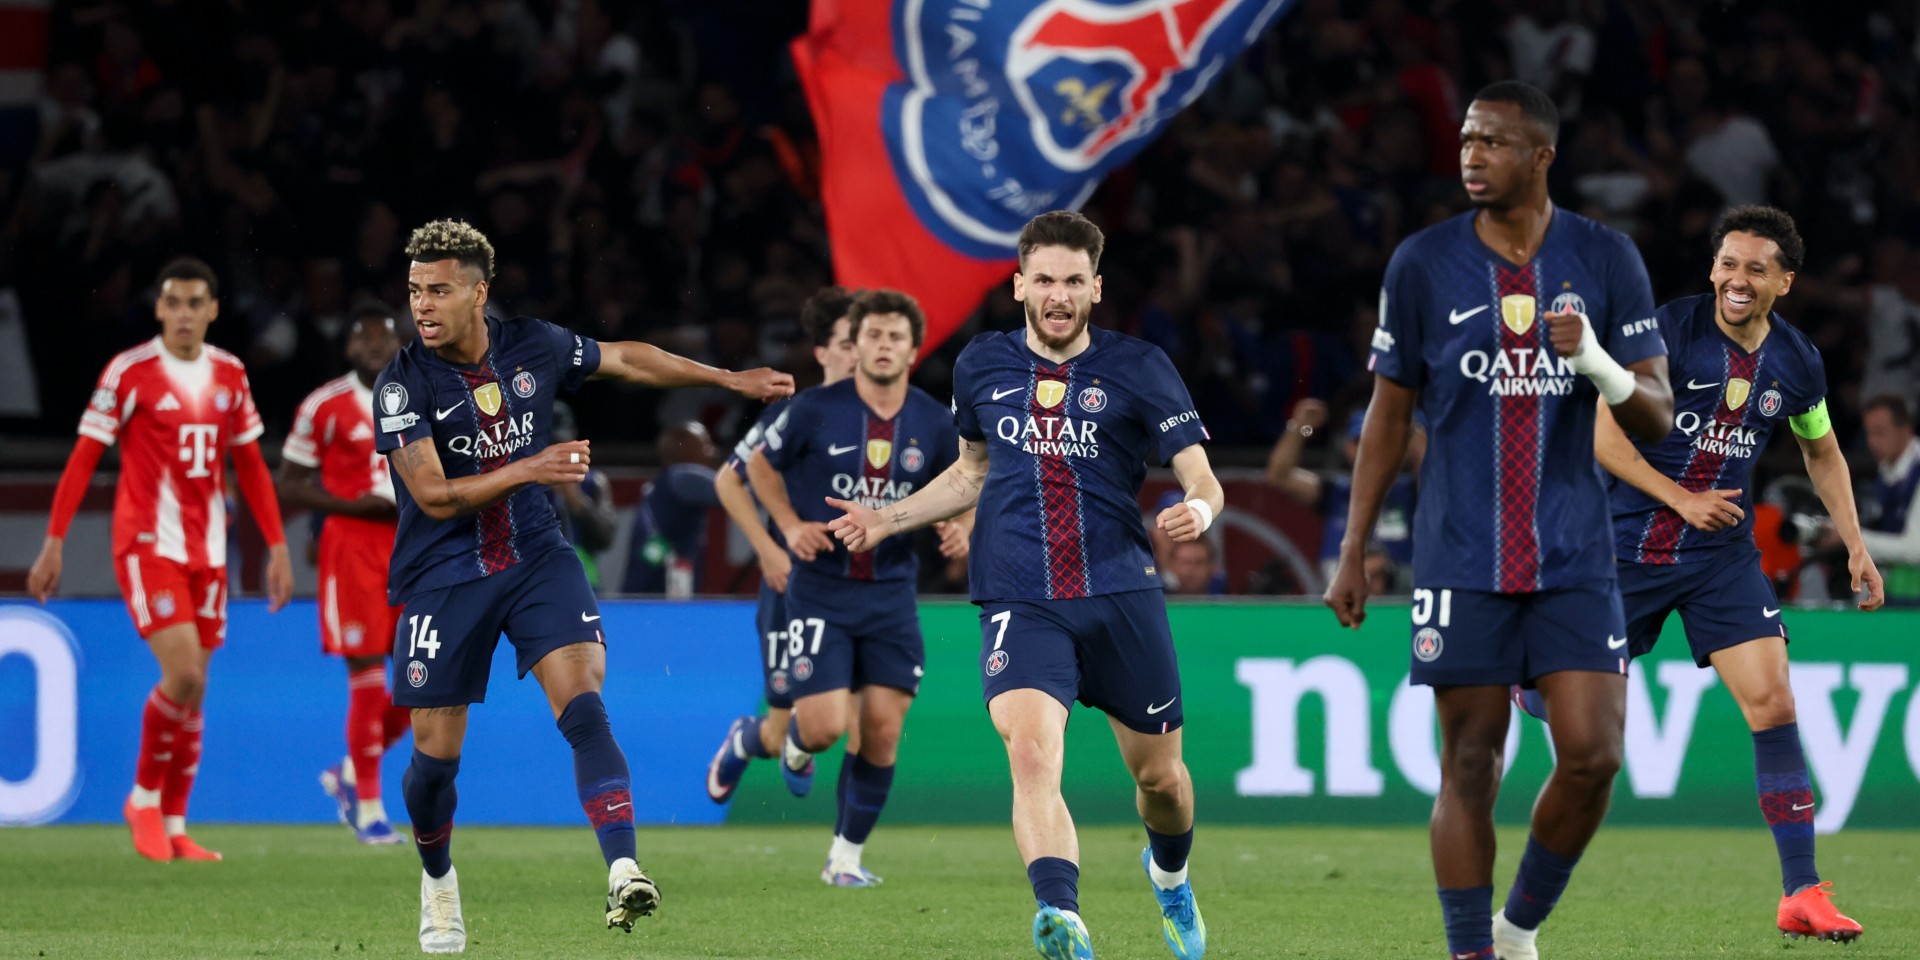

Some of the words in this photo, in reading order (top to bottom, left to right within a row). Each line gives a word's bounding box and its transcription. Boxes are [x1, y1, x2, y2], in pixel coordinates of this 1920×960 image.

[1488, 376, 1575, 396] AIRWAYS
[448, 412, 534, 456] QATAR
[997, 416, 1099, 446] QATAR
[1675, 411, 1760, 445] QATAR
[474, 432, 533, 459] AIRWAYS
[1022, 441, 1099, 459] AIRWAYS
[1690, 435, 1753, 459] AIRWAYS
[832, 473, 913, 499] QATAR
[1411, 588, 1452, 628] 51
[408, 614, 442, 659] 14
[788, 618, 825, 657] 87
[991, 610, 1011, 650] 7
[1788, 662, 1920, 835] y
